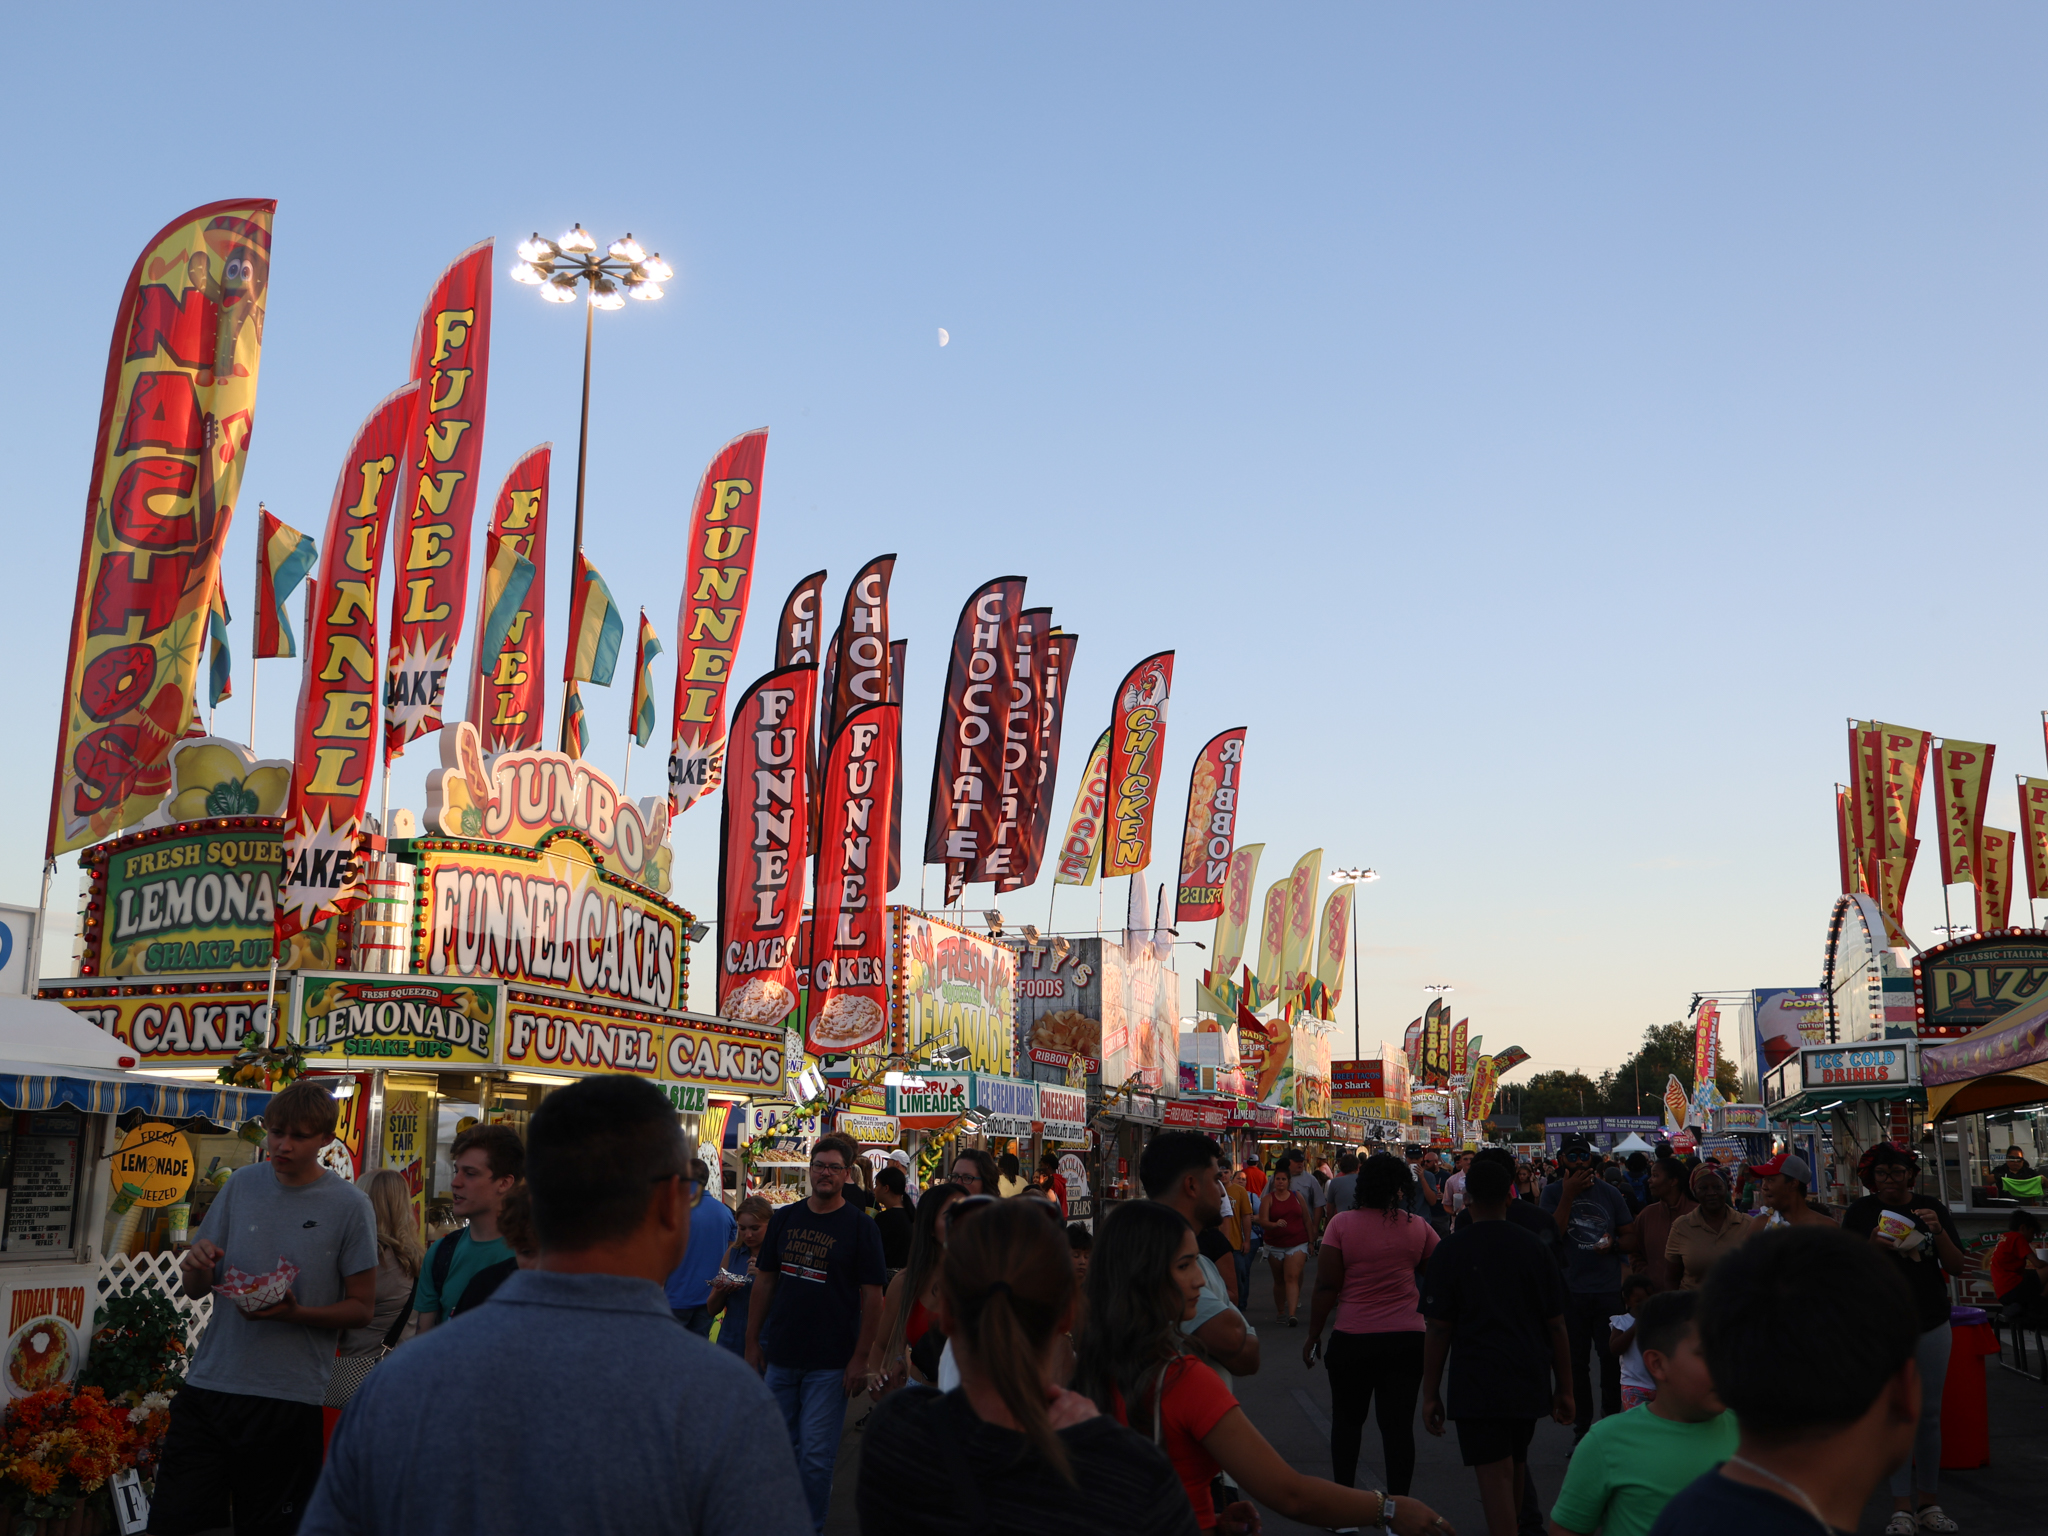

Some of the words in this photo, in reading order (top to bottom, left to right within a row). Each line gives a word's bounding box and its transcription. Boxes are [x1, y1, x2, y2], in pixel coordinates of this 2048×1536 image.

[403, 308, 474, 624] FUNNEL
[74, 285, 219, 816] NACHOS
[679, 478, 753, 723] FUNNEL
[388, 669, 446, 707] AKE
[946, 592, 1003, 858] CHOCOLATE
[1115, 707, 1158, 867] CHICKEN
[484, 764, 643, 873] JUMBO
[754, 688, 797, 931] FUNNEL
[1947, 750, 1976, 875] PIZZA
[834, 724, 879, 949] FUNNEL
[125, 843, 201, 883] FRESH
[206, 840, 282, 865] SQUEE
[116, 872, 277, 939] LEMONA
[430, 868, 572, 980] FUNNEL
[579, 888, 674, 1008] CAKES
[725, 936, 795, 973] CAKES
[1959, 952, 2000, 962] CLASSIC
[815, 956, 883, 991] CAKES
[937, 936, 989, 1003] FRESH
[360, 988, 386, 1000] FRESH
[386, 988, 439, 1000] SQUEEZED
[942, 980, 981, 1007] SQUEEZED
[1018, 979, 1064, 998] FOODS
[1783, 1000, 1823, 1008] POPC
[131, 1002, 280, 1055] CAKES
[305, 1001, 490, 1056] LEMONADE
[909, 992, 1011, 1076] LEMONADE
[1427, 1017, 1439, 1067] BBQ
[344, 1039, 452, 1058] SHAKE-UPS
[509, 1014, 657, 1074] FUNNEL
[668, 1033, 780, 1084] CAKES
[1036, 1050, 1069, 1065] RIBBON
[1454, 1025, 1466, 1071] FUNNEL
[1815, 1053, 1843, 1068] ICE
[1850, 1051, 1895, 1065] COLD
[1345, 1081, 1370, 1089] Shark
[1476, 1060, 1487, 1088] CORN
[1822, 1066, 1888, 1084] DRINKS
[900, 1095, 965, 1112] LIMEADES
[978, 1082, 991, 1113] ICE
[992, 1082, 1014, 1114] CREAM
[1016, 1086, 1033, 1116] BARS
[1040, 1090, 1085, 1123] CHEESECAKE
[1348, 1106, 1381, 1117] GYROS
[1471, 1092, 1483, 1119] DOGS
[47, 1119, 75, 1130] PEPSI
[390, 1116, 417, 1132] STATE
[844, 1120, 894, 1143] BANANAS
[984, 1118, 1013, 1134] CHOCOLATE
[1044, 1125, 1067, 1138] CHOCOLATE
[141, 1131, 177, 1147] FRESH
[393, 1134, 413, 1150] FAIR
[121, 1154, 188, 1177] LEMONADE
[140, 1187, 177, 1201] UEEZED
[1073, 1200, 1091, 1215] BARS
[785, 1240, 828, 1258] AROUND
[787, 1228, 837, 1249] TKACHUK
[8, 1287, 55, 1339] INDIAN
[57, 1286, 84, 1329] TACO
